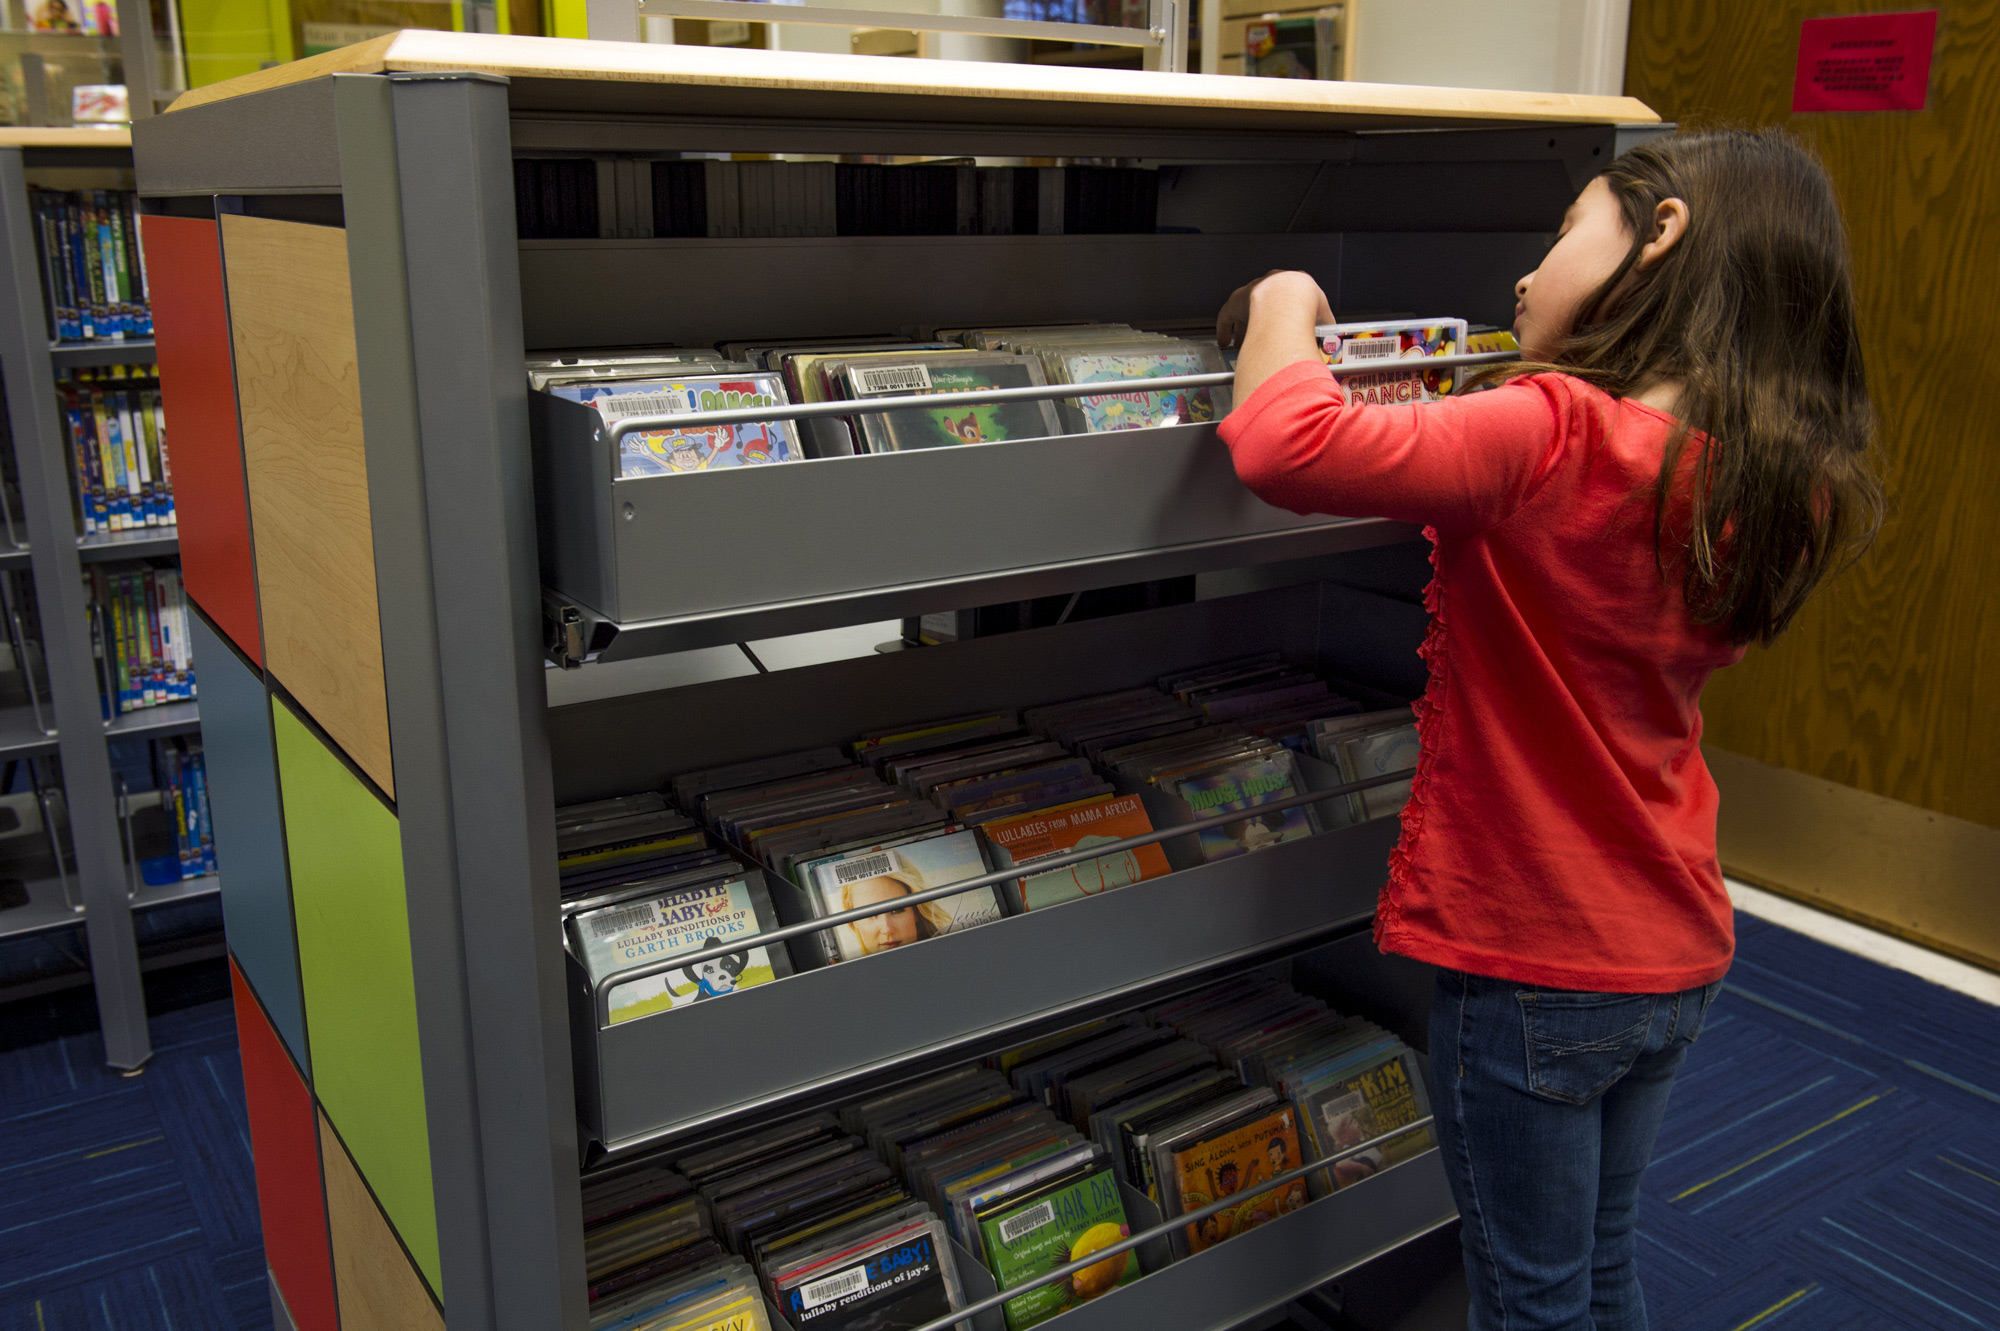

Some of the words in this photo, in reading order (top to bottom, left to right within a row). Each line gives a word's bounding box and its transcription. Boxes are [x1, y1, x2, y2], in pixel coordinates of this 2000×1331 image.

[1352, 380, 1421, 407] DANCE
[1188, 784, 1241, 811] MOUSE
[1241, 772, 1291, 798] HOUSE
[996, 822, 1048, 844] LULLABIES
[1048, 818, 1067, 831] FROM
[1070, 808, 1102, 825] MAMA
[1105, 799, 1138, 817] AFRICA
[617, 931, 663, 949] LULLABY
[667, 914, 731, 937] RENDITIONS
[733, 910, 747, 921] OF
[625, 937, 681, 959] GARTH
[686, 921, 745, 944] BROOKS
[1185, 1157, 1205, 1173] SING
[1209, 1146, 1236, 1163] ALONG
[1254, 1118, 1294, 1143] PUTUMAO
[1050, 1187, 1088, 1231] HAIR
[1091, 1173, 1120, 1212] DAY
[880, 1240, 931, 1274] BABY!
[1014, 1246, 1031, 1260] Original
[1031, 1241, 1044, 1252] Songs
[800, 1302, 837, 1322] lullaby
[839, 1278, 893, 1307] renditions
[894, 1272, 906, 1283] of
[906, 1264, 930, 1280] jay-z
